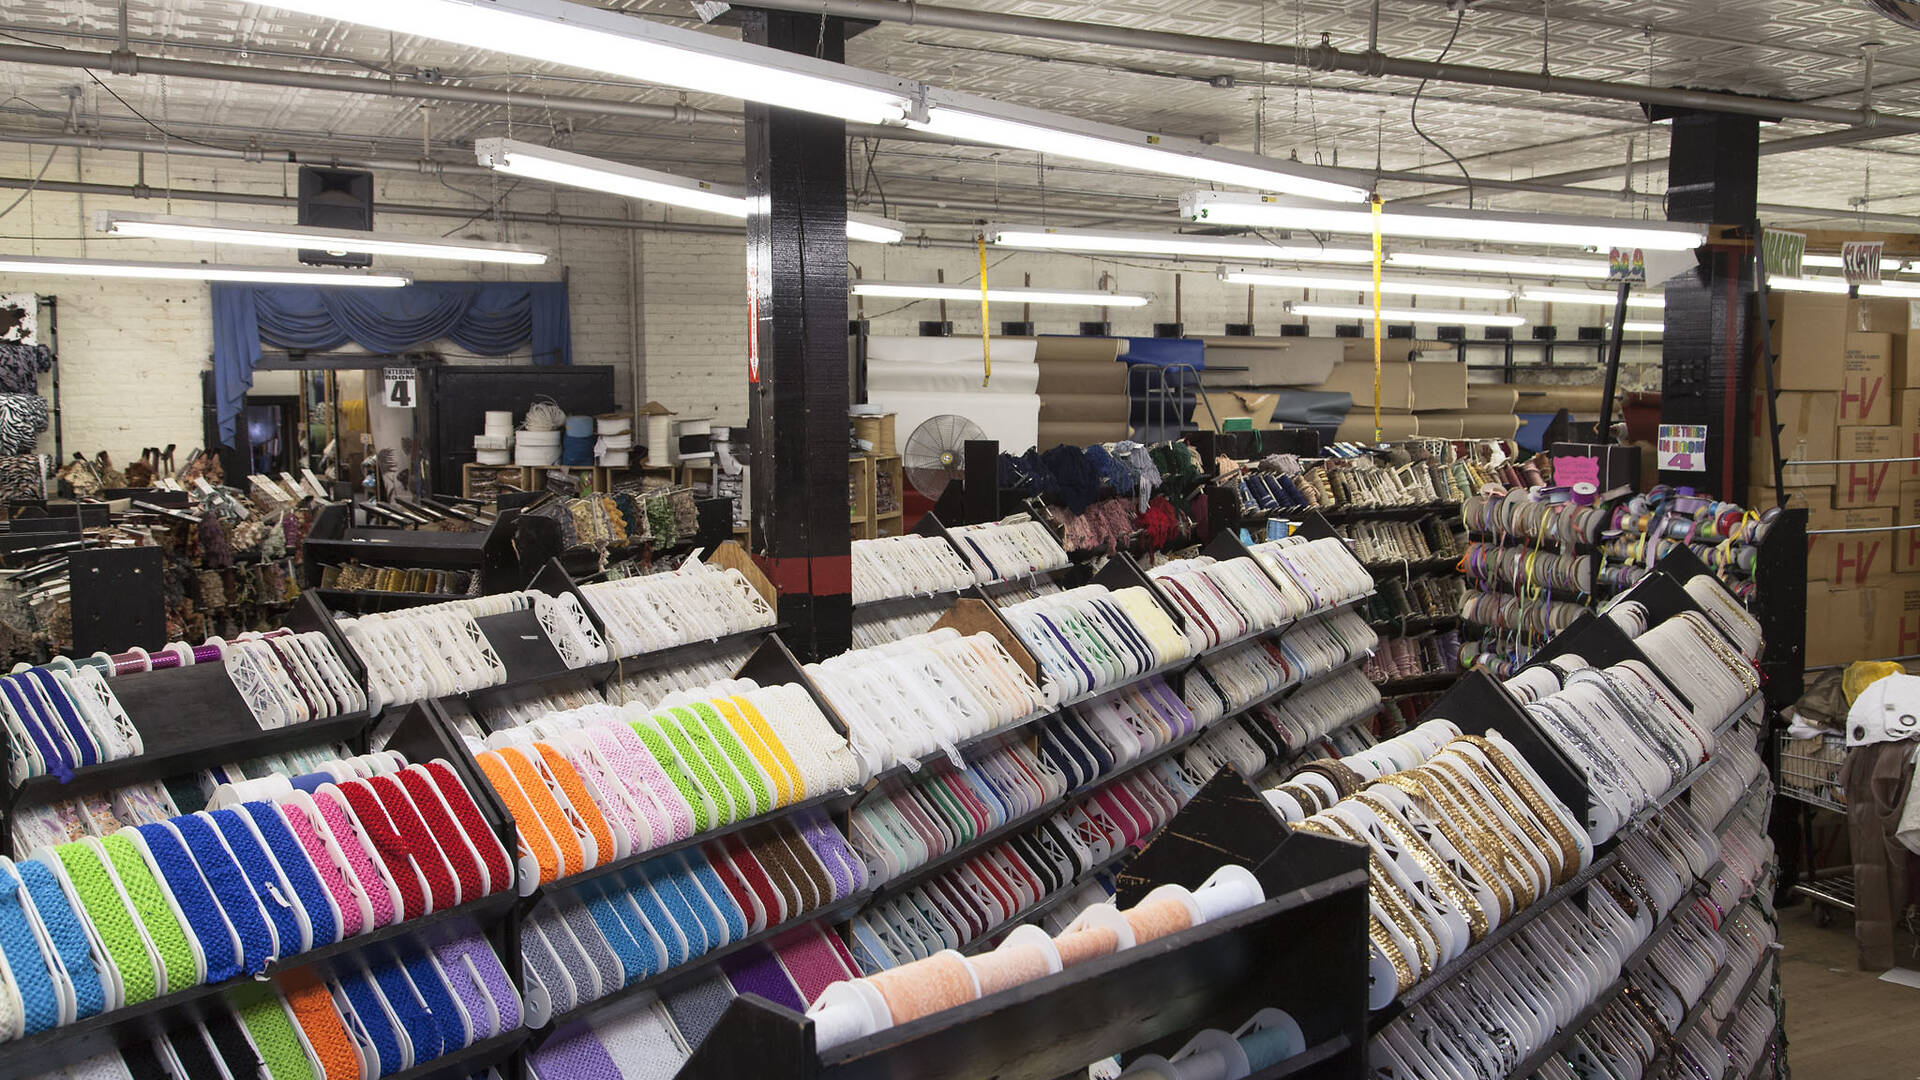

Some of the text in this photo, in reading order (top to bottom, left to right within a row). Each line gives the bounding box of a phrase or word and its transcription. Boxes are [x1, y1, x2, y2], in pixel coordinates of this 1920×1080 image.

[391, 381, 411, 406] 4
[1659, 440, 1705, 453] IN ROOM
[1668, 453, 1694, 469] 4
[1848, 462, 1889, 503] HV
[1836, 541, 1880, 585] HV
